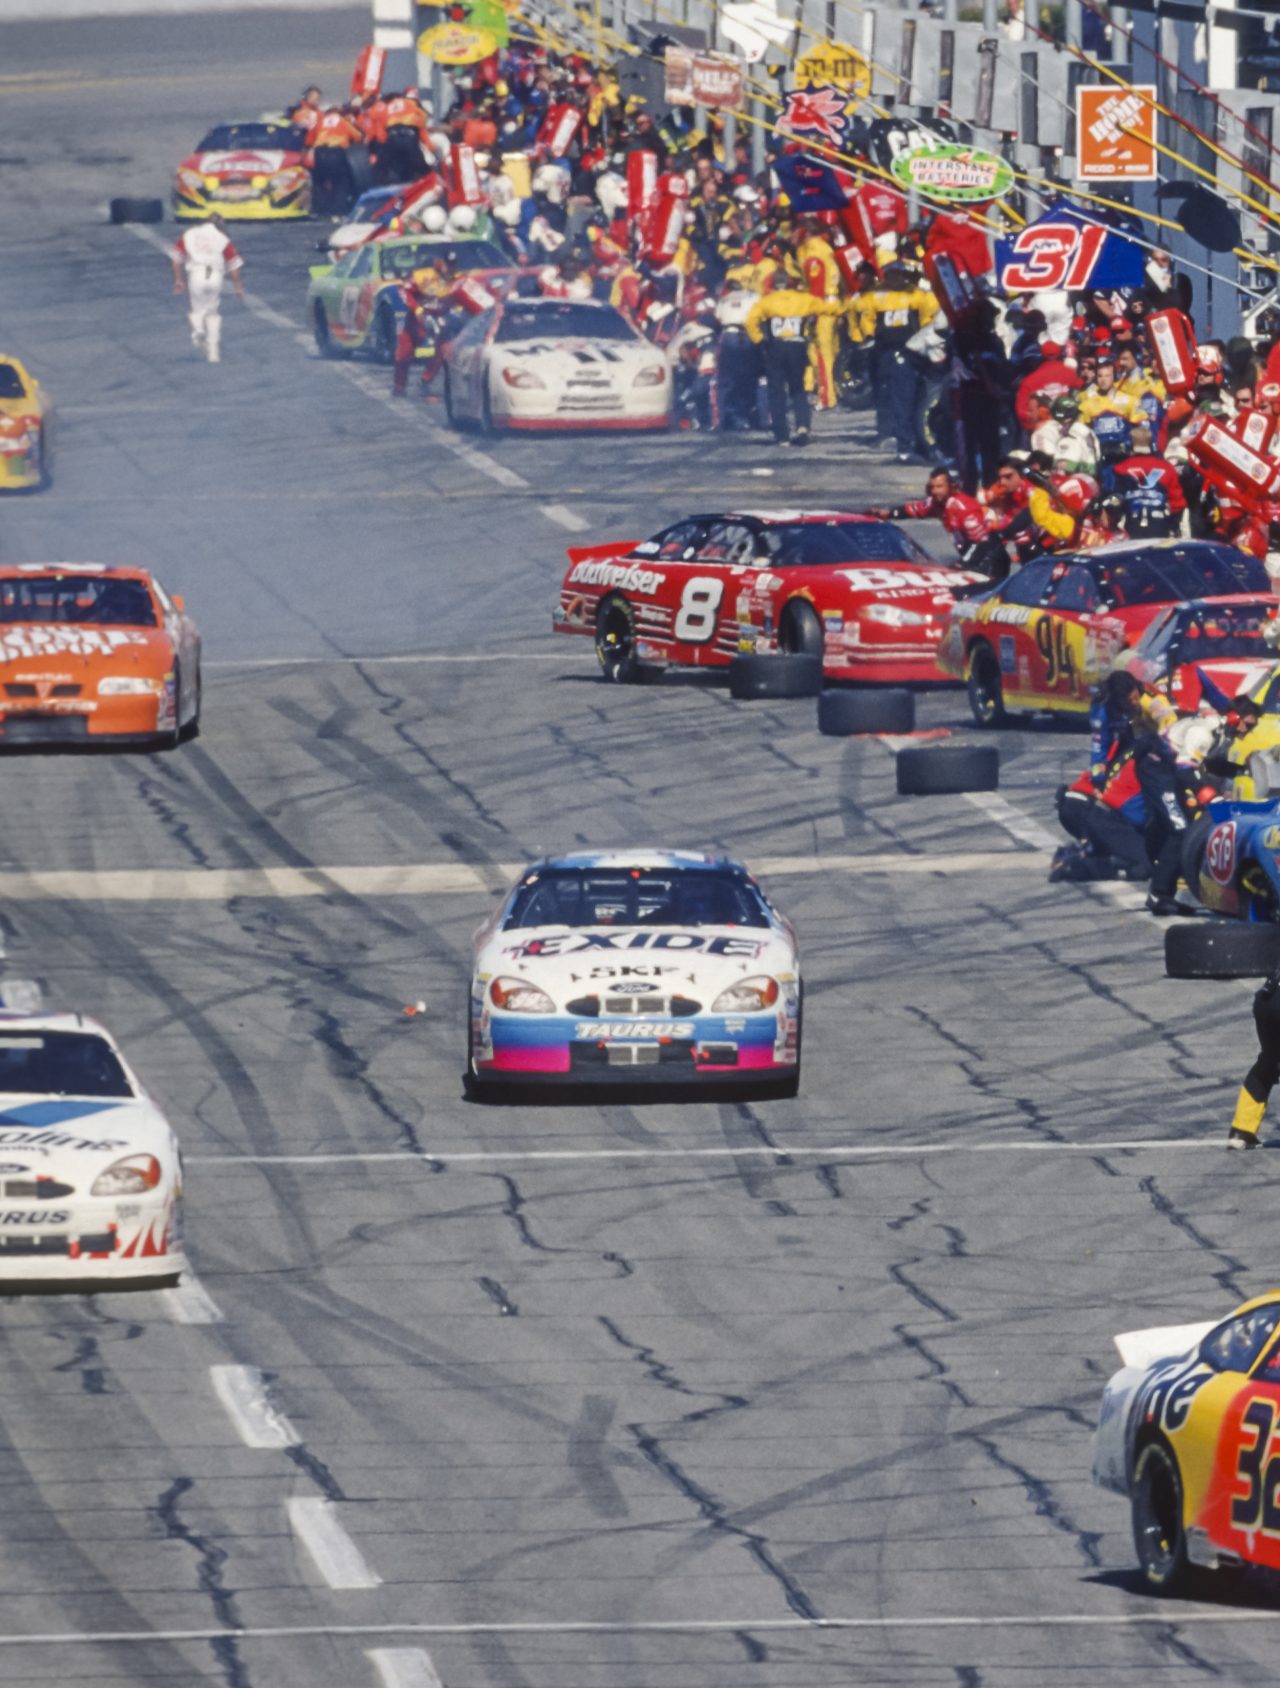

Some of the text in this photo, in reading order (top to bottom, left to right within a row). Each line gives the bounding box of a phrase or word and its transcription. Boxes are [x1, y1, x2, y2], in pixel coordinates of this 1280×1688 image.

[1088, 95, 1146, 143] HOME
[1096, 96, 1119, 116] THE
[912, 160, 996, 174] INTERSTATE
[917, 172, 991, 185] BATTERIES
[1002, 223, 1107, 291] 31
[884, 310, 909, 326] CAT
[569, 558, 667, 595] Budweiser
[675, 577, 724, 641] 8
[1035, 615, 1080, 698] 94
[1209, 825, 1232, 871] STP
[512, 933, 765, 958] EXIDE
[577, 1022, 695, 1039] TAURUS
